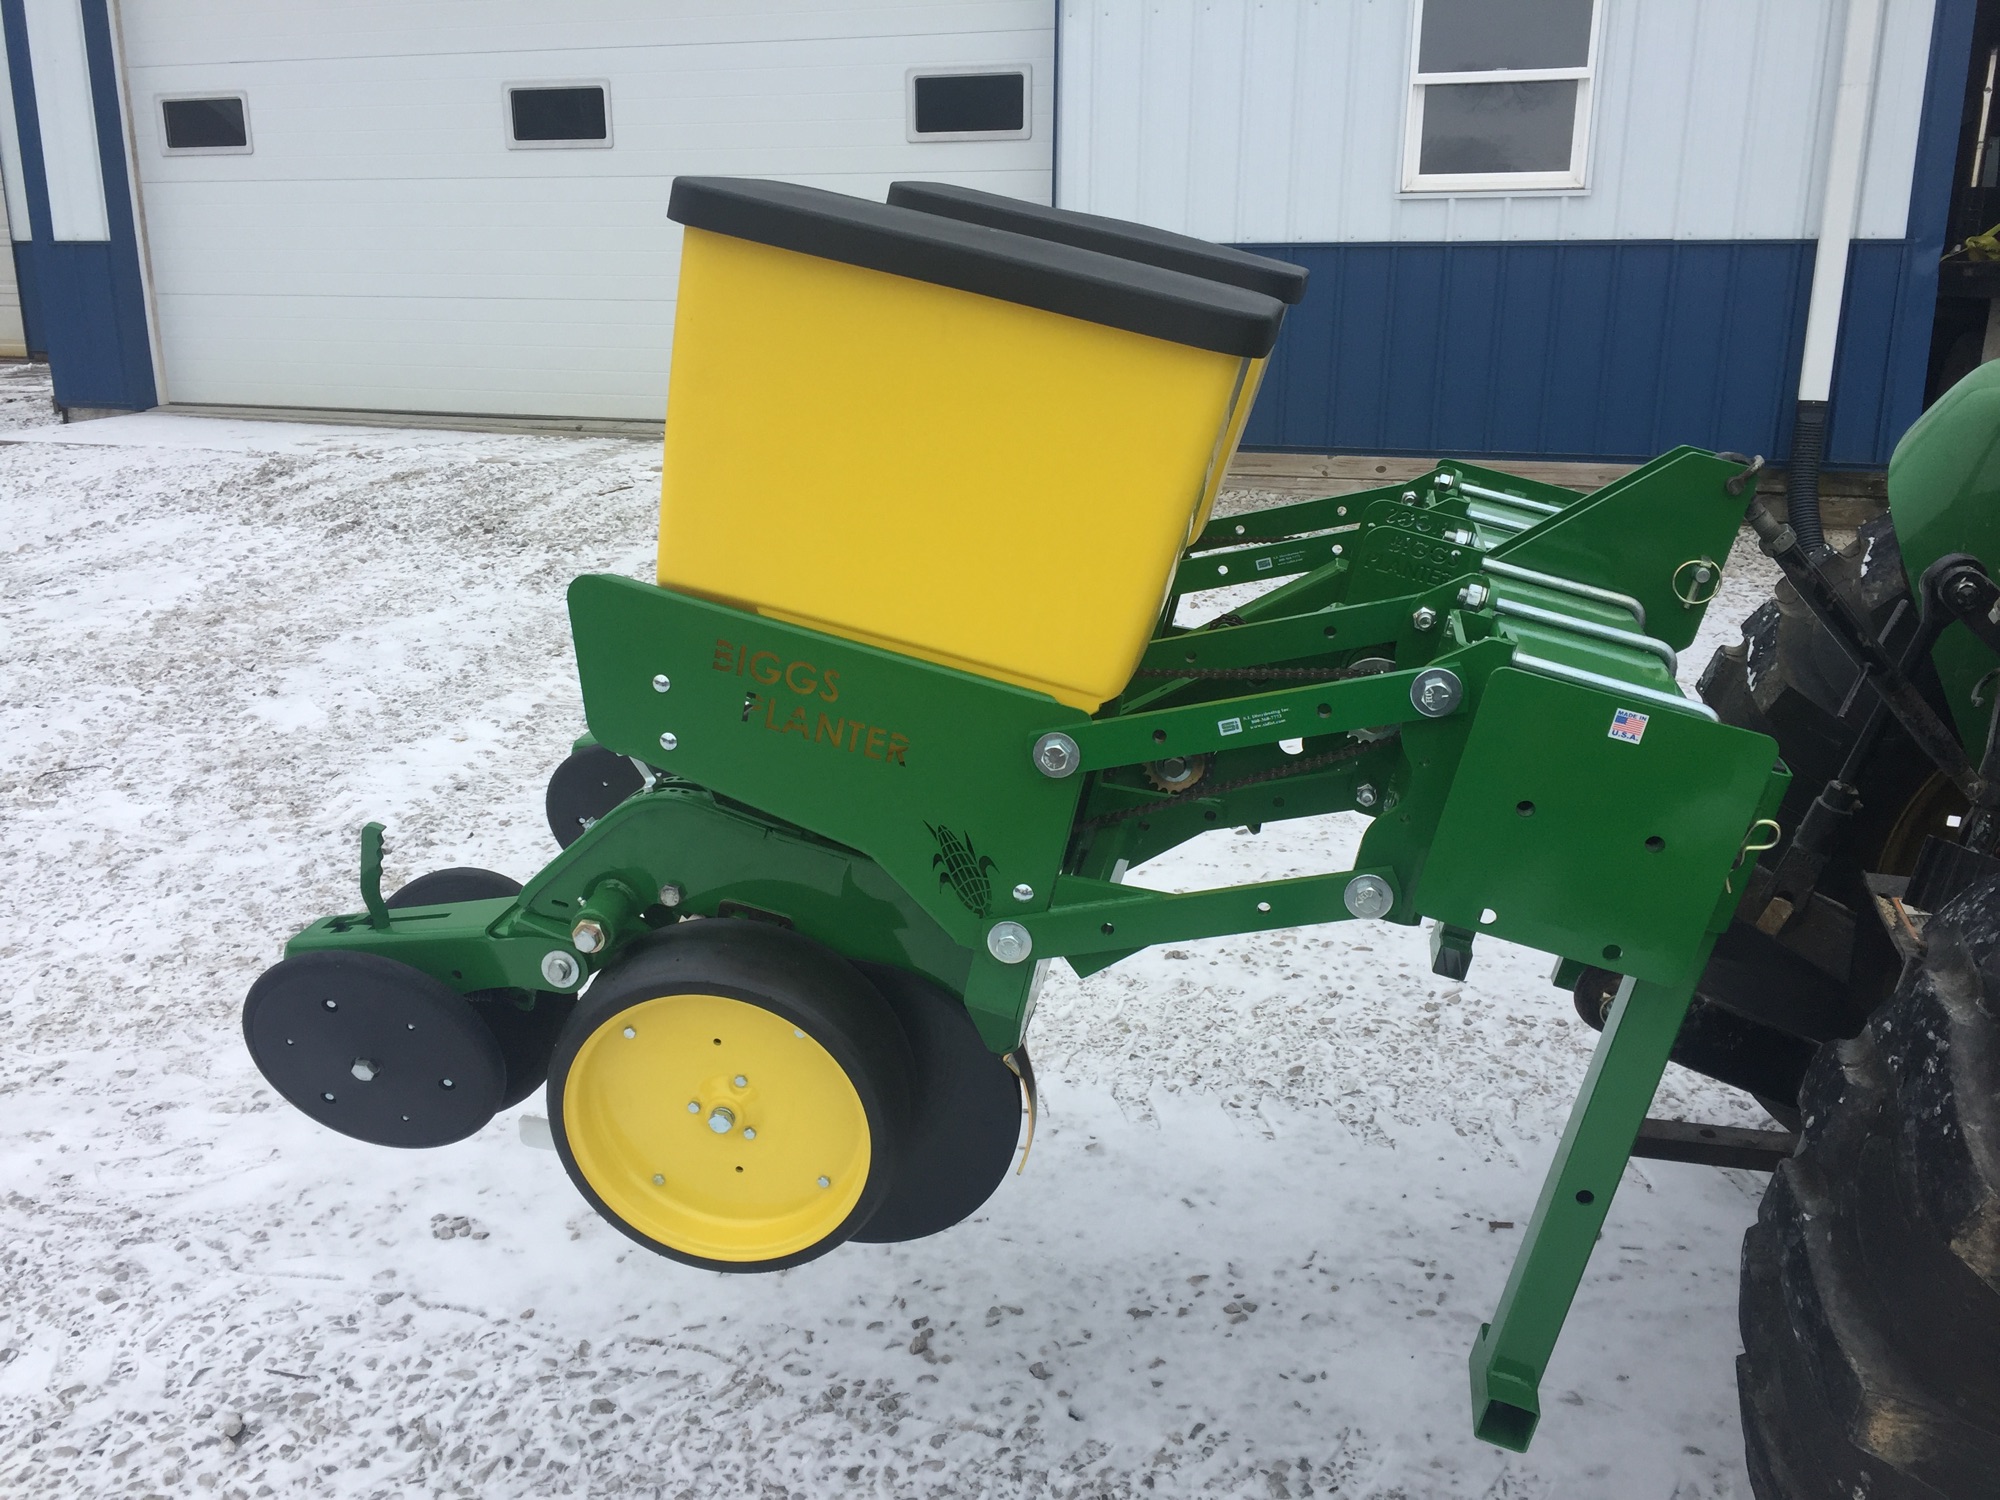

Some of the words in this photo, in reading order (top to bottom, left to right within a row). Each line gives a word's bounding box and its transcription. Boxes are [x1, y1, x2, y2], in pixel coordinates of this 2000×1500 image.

[1388, 536, 1462, 569] BIGGS
[712, 639, 841, 703] BIGGS
[741, 691, 910, 768] PLANTER
[1617, 710, 1637, 718] MADE
[1611, 730, 1639, 741] U.S.A.
